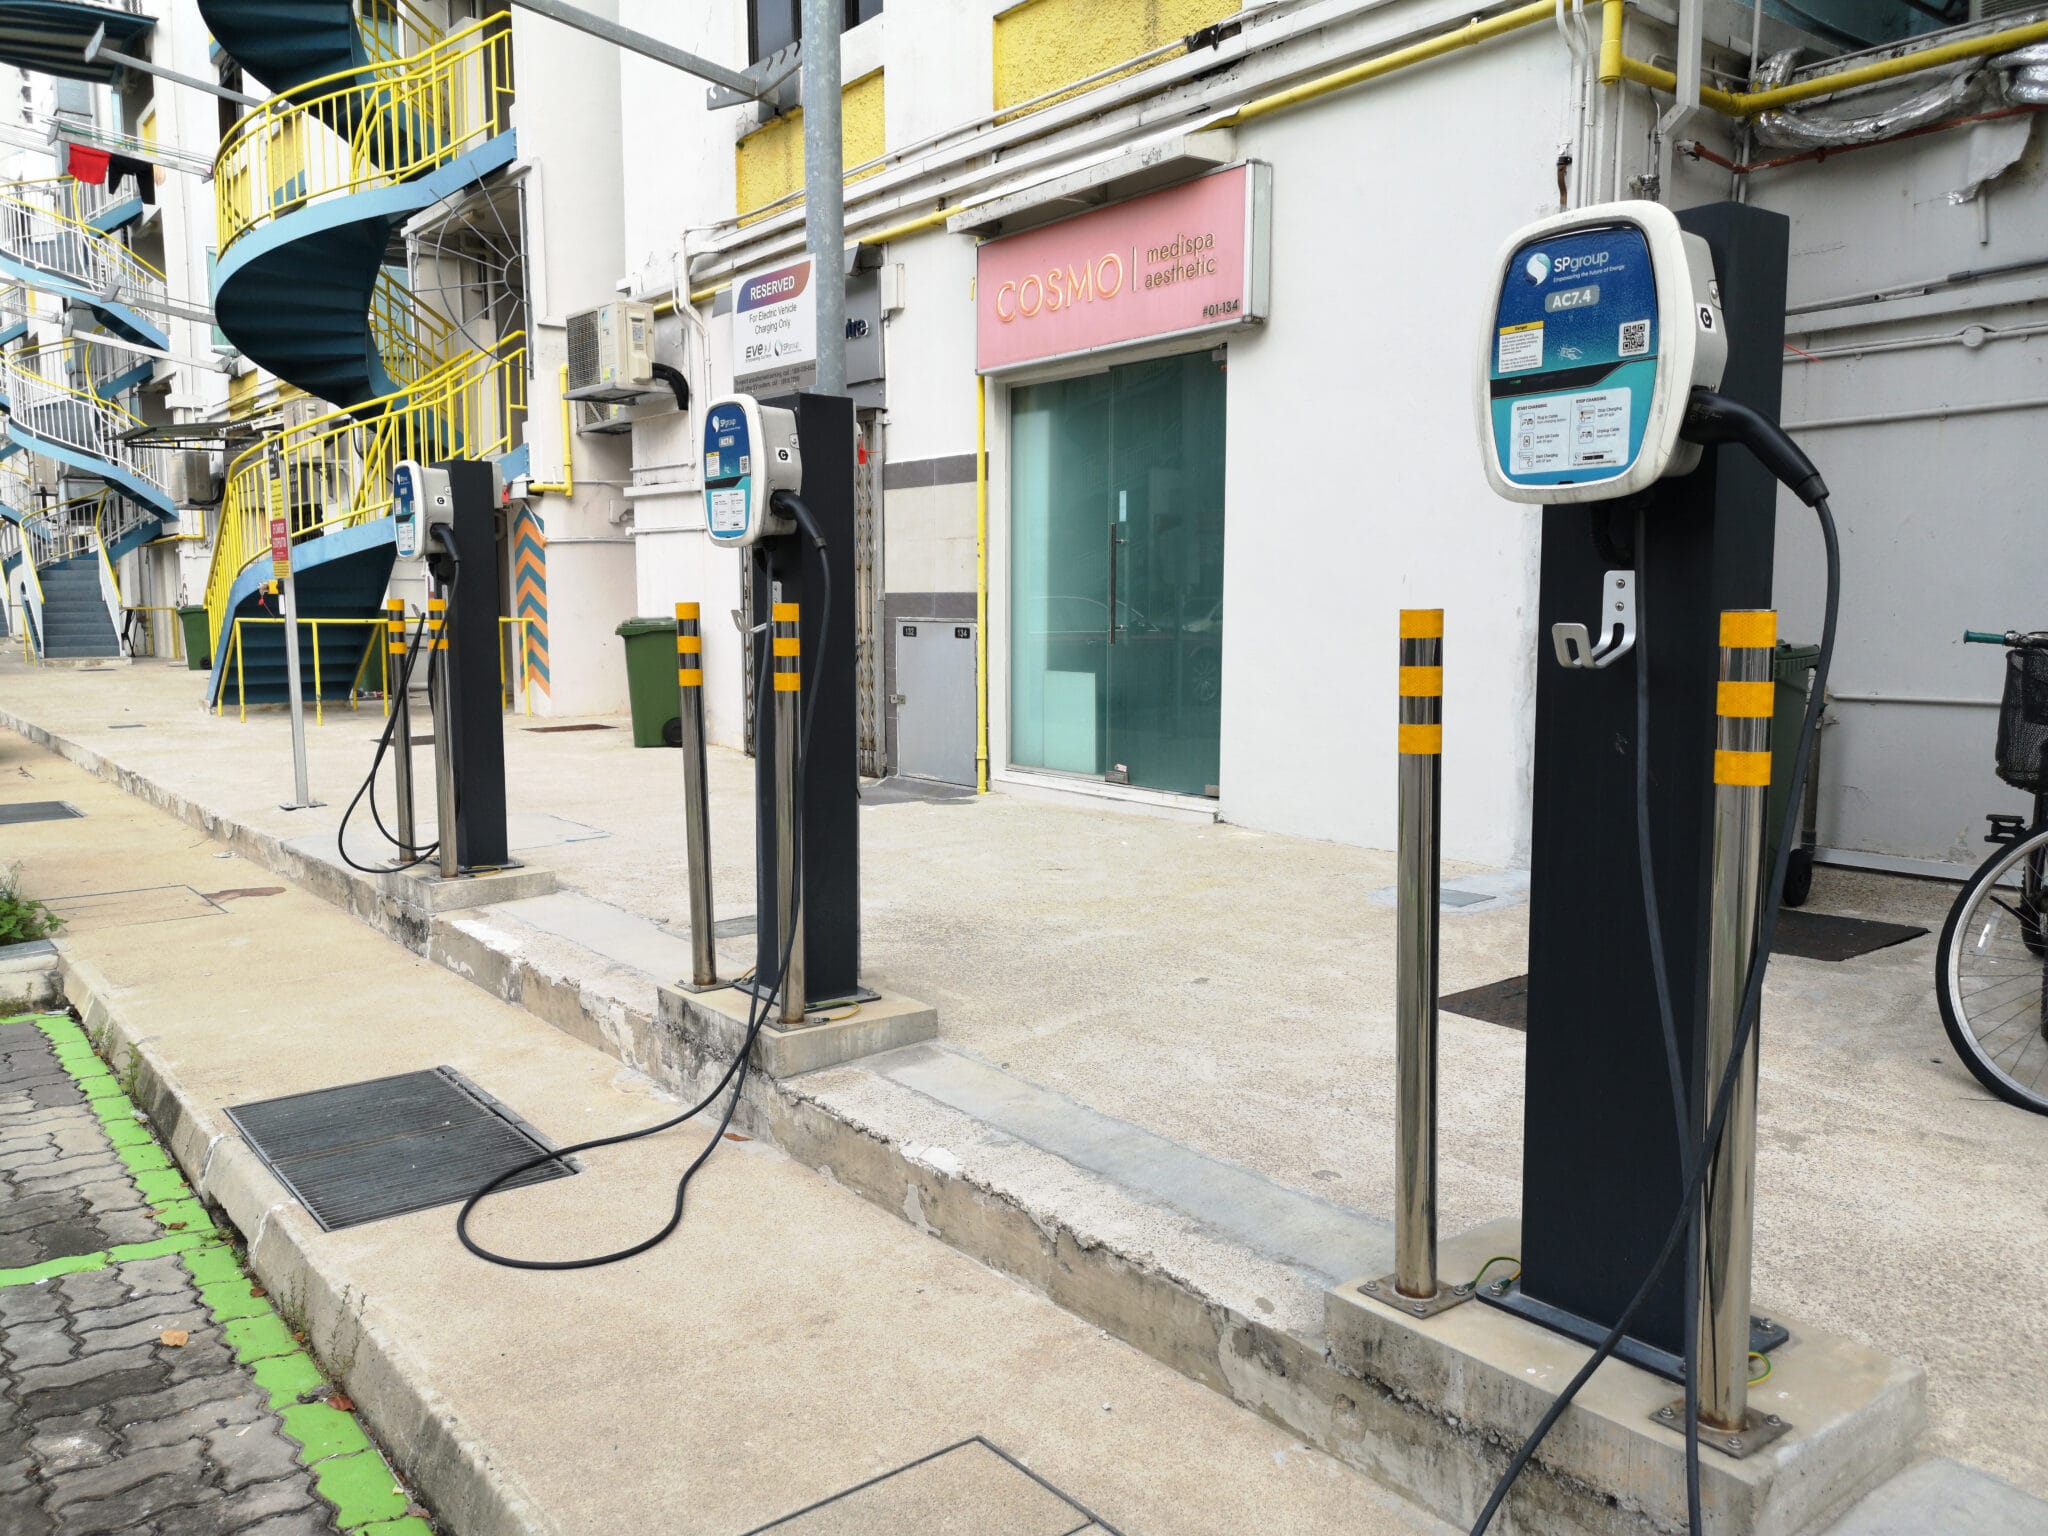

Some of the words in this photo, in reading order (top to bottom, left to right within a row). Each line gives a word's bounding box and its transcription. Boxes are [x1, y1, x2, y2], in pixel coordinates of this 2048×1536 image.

[1147, 232, 1216, 264] medispa
[1144, 254, 1217, 290] aesthetic
[1553, 251, 1609, 273] SPgroup
[750, 275, 795, 301] RESERVED
[995, 252, 1123, 323] COSMO
[1202, 299, 1239, 318] #01-134
[1552, 289, 1592, 309] AC7.4
[749, 313, 758, 323] For
[759, 308, 778, 321] Electric
[778, 302, 797, 315] Vehicle
[754, 321, 778, 335] Charging
[778, 319, 791, 329] Only
[846, 318, 869, 339] tre
